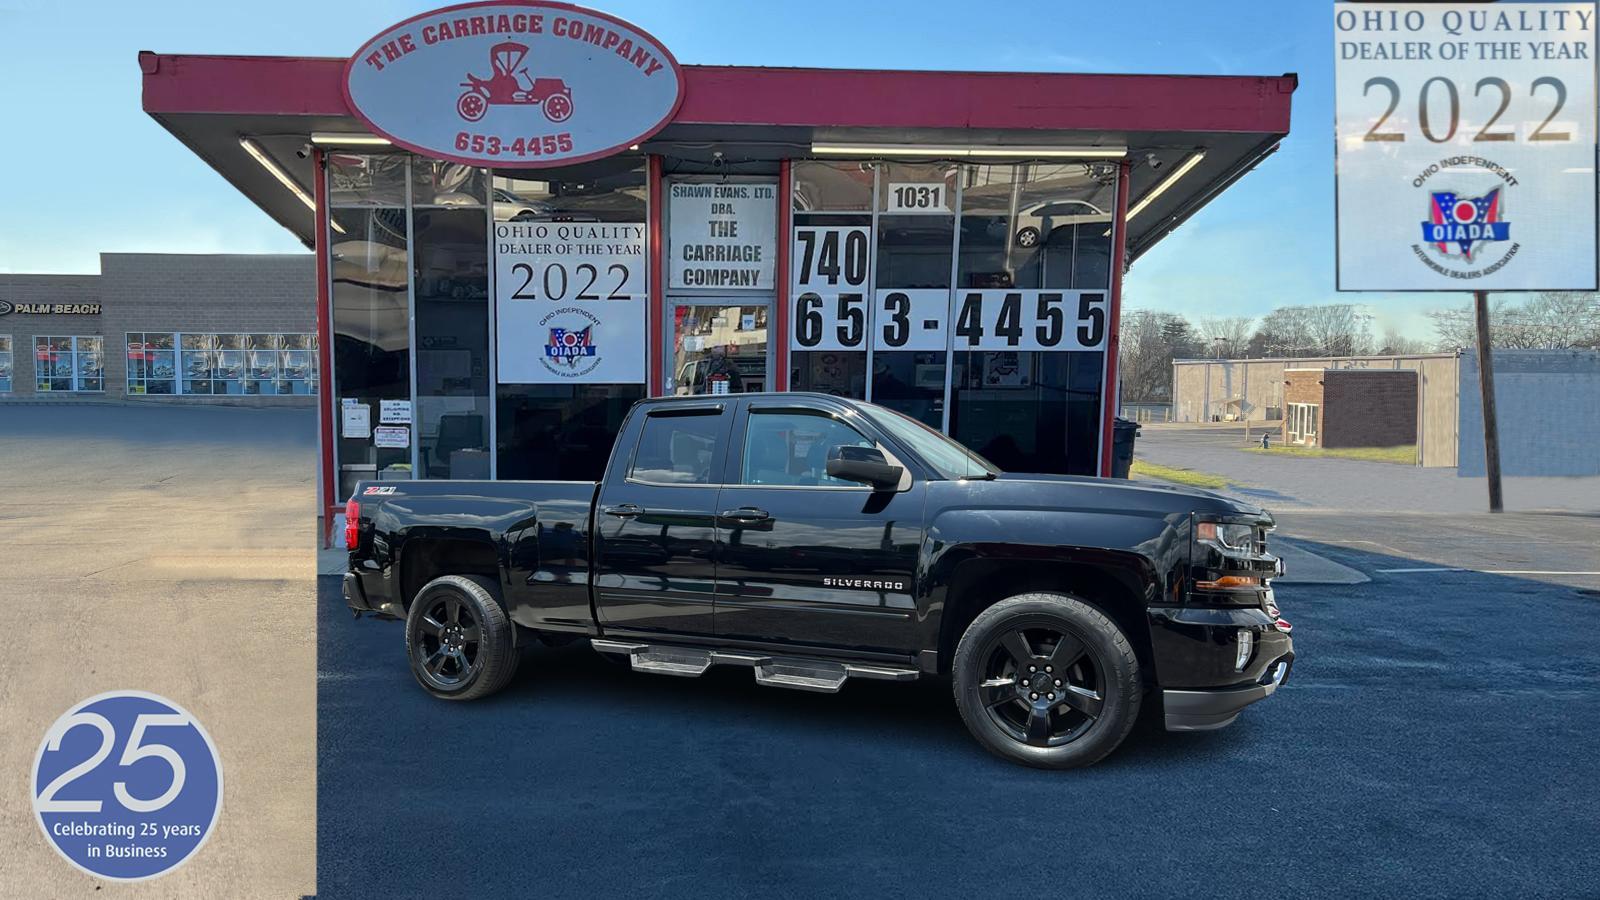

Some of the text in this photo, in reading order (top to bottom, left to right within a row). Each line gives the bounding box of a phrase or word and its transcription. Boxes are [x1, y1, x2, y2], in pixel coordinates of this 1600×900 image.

[1336, 10, 1593, 35] OHIO QUALITY
[366, 14, 664, 77] THE CARRIAGE COMPANY
[1340, 42, 1589, 60] DEALER OF THE YEAR
[1363, 76, 1571, 143] 2022
[455, 132, 573, 156] 653-4455
[1412, 156, 1519, 188] OHIO INDEPENDENT
[673, 186, 712, 199] SHAWN
[754, 187, 774, 199] LTD.
[894, 187, 940, 208] 1031
[711, 203, 736, 215] DBA.
[497, 226, 644, 241] OHIO QUALITY
[709, 221, 738, 237] THE
[1432, 224, 1495, 240] OIADA
[499, 244, 642, 255] DEALER OF THE YEAR
[683, 244, 762, 262] CARRIAGE
[797, 230, 868, 286] 740
[1411, 242, 1521, 280] AUTOMOBILE DEALERS ASSOCIATION
[511, 263, 631, 301] 2022
[683, 269, 760, 286] COMPANY
[15, 303, 101, 314] PALM BEACH
[539, 307, 601, 326] OHIO INDEPENDENT
[551, 346, 588, 356] OIADA
[823, 578, 903, 590] SILVERADO
